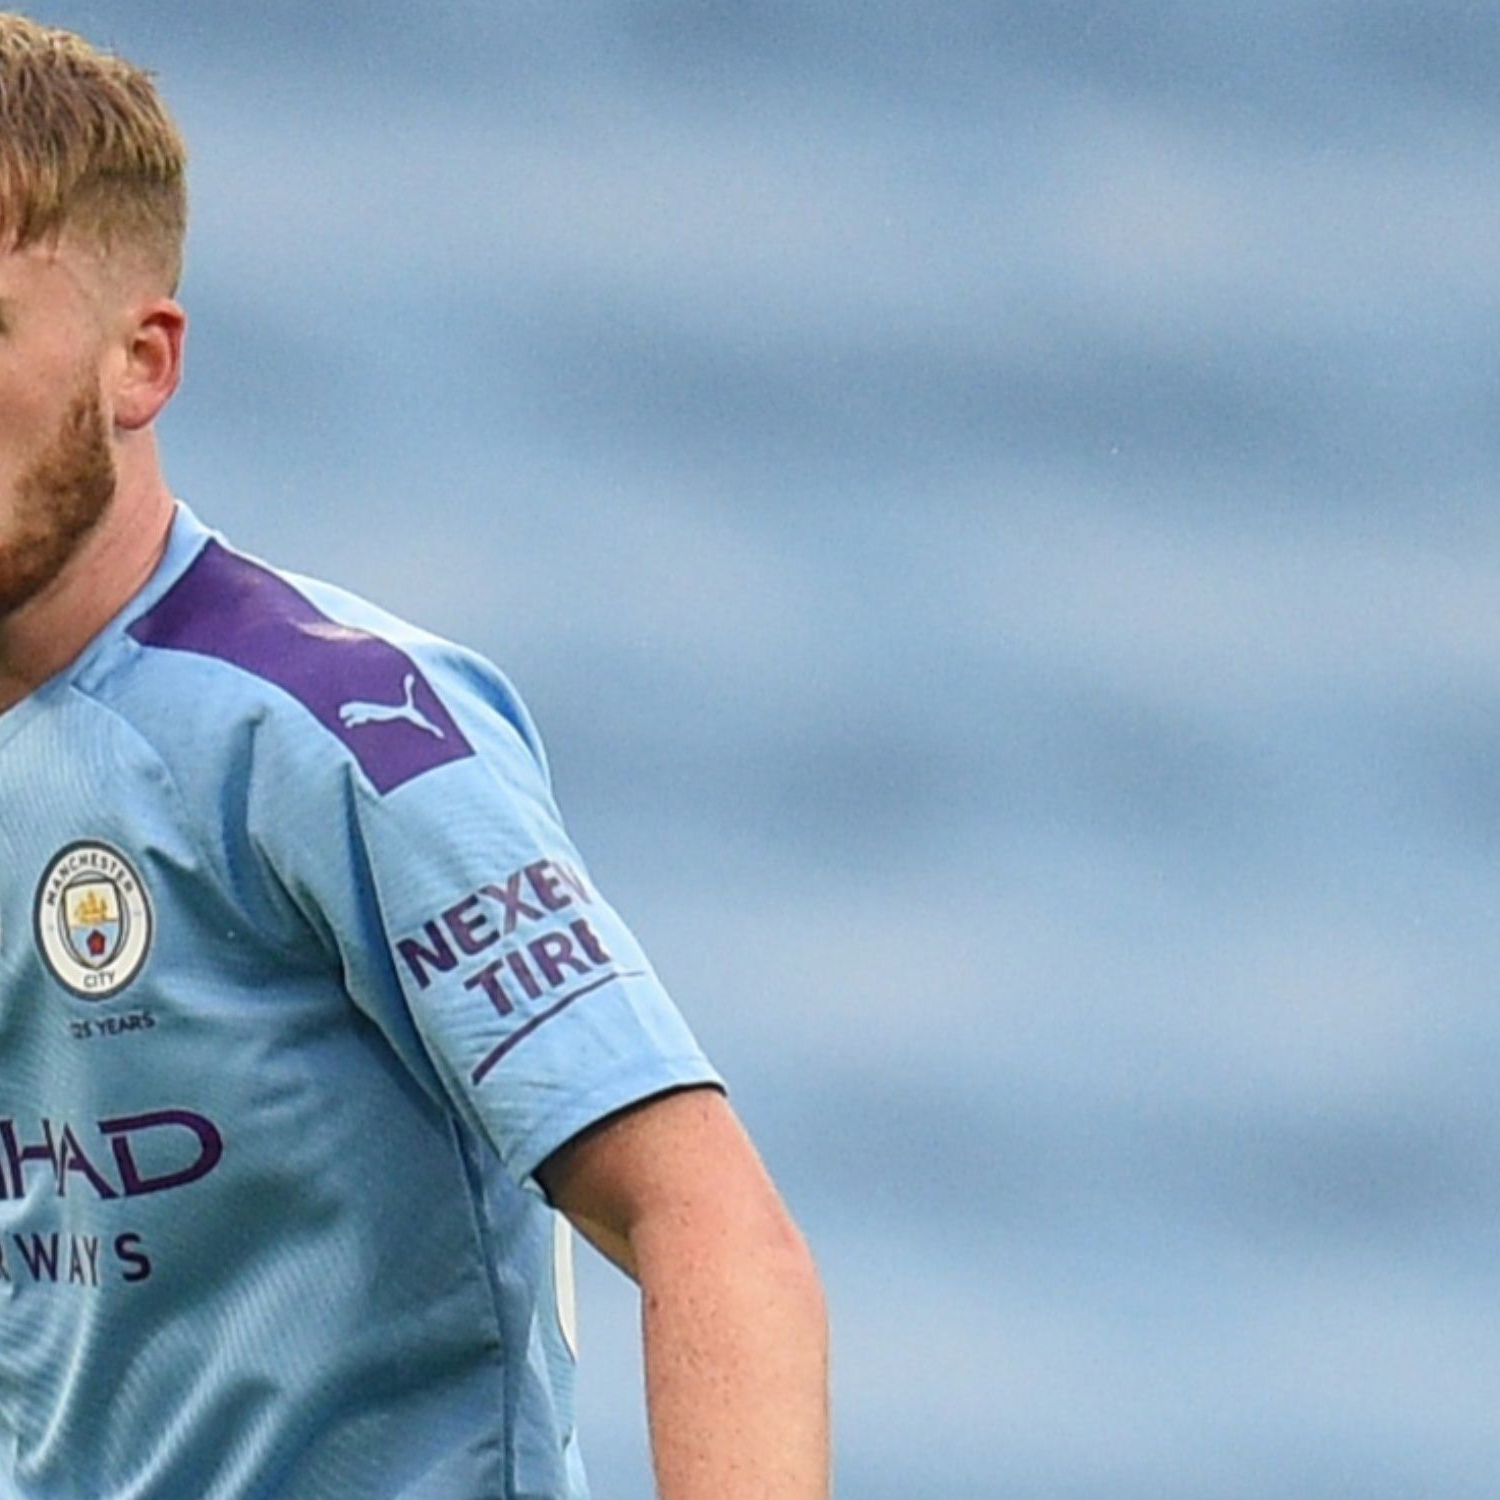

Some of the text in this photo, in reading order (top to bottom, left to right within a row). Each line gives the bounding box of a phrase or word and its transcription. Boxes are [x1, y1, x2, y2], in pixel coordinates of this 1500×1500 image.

[46, 853, 134, 906] MANCHESTER
[83, 971, 115, 988] CITY
[95, 1011, 155, 1036] YEARS
